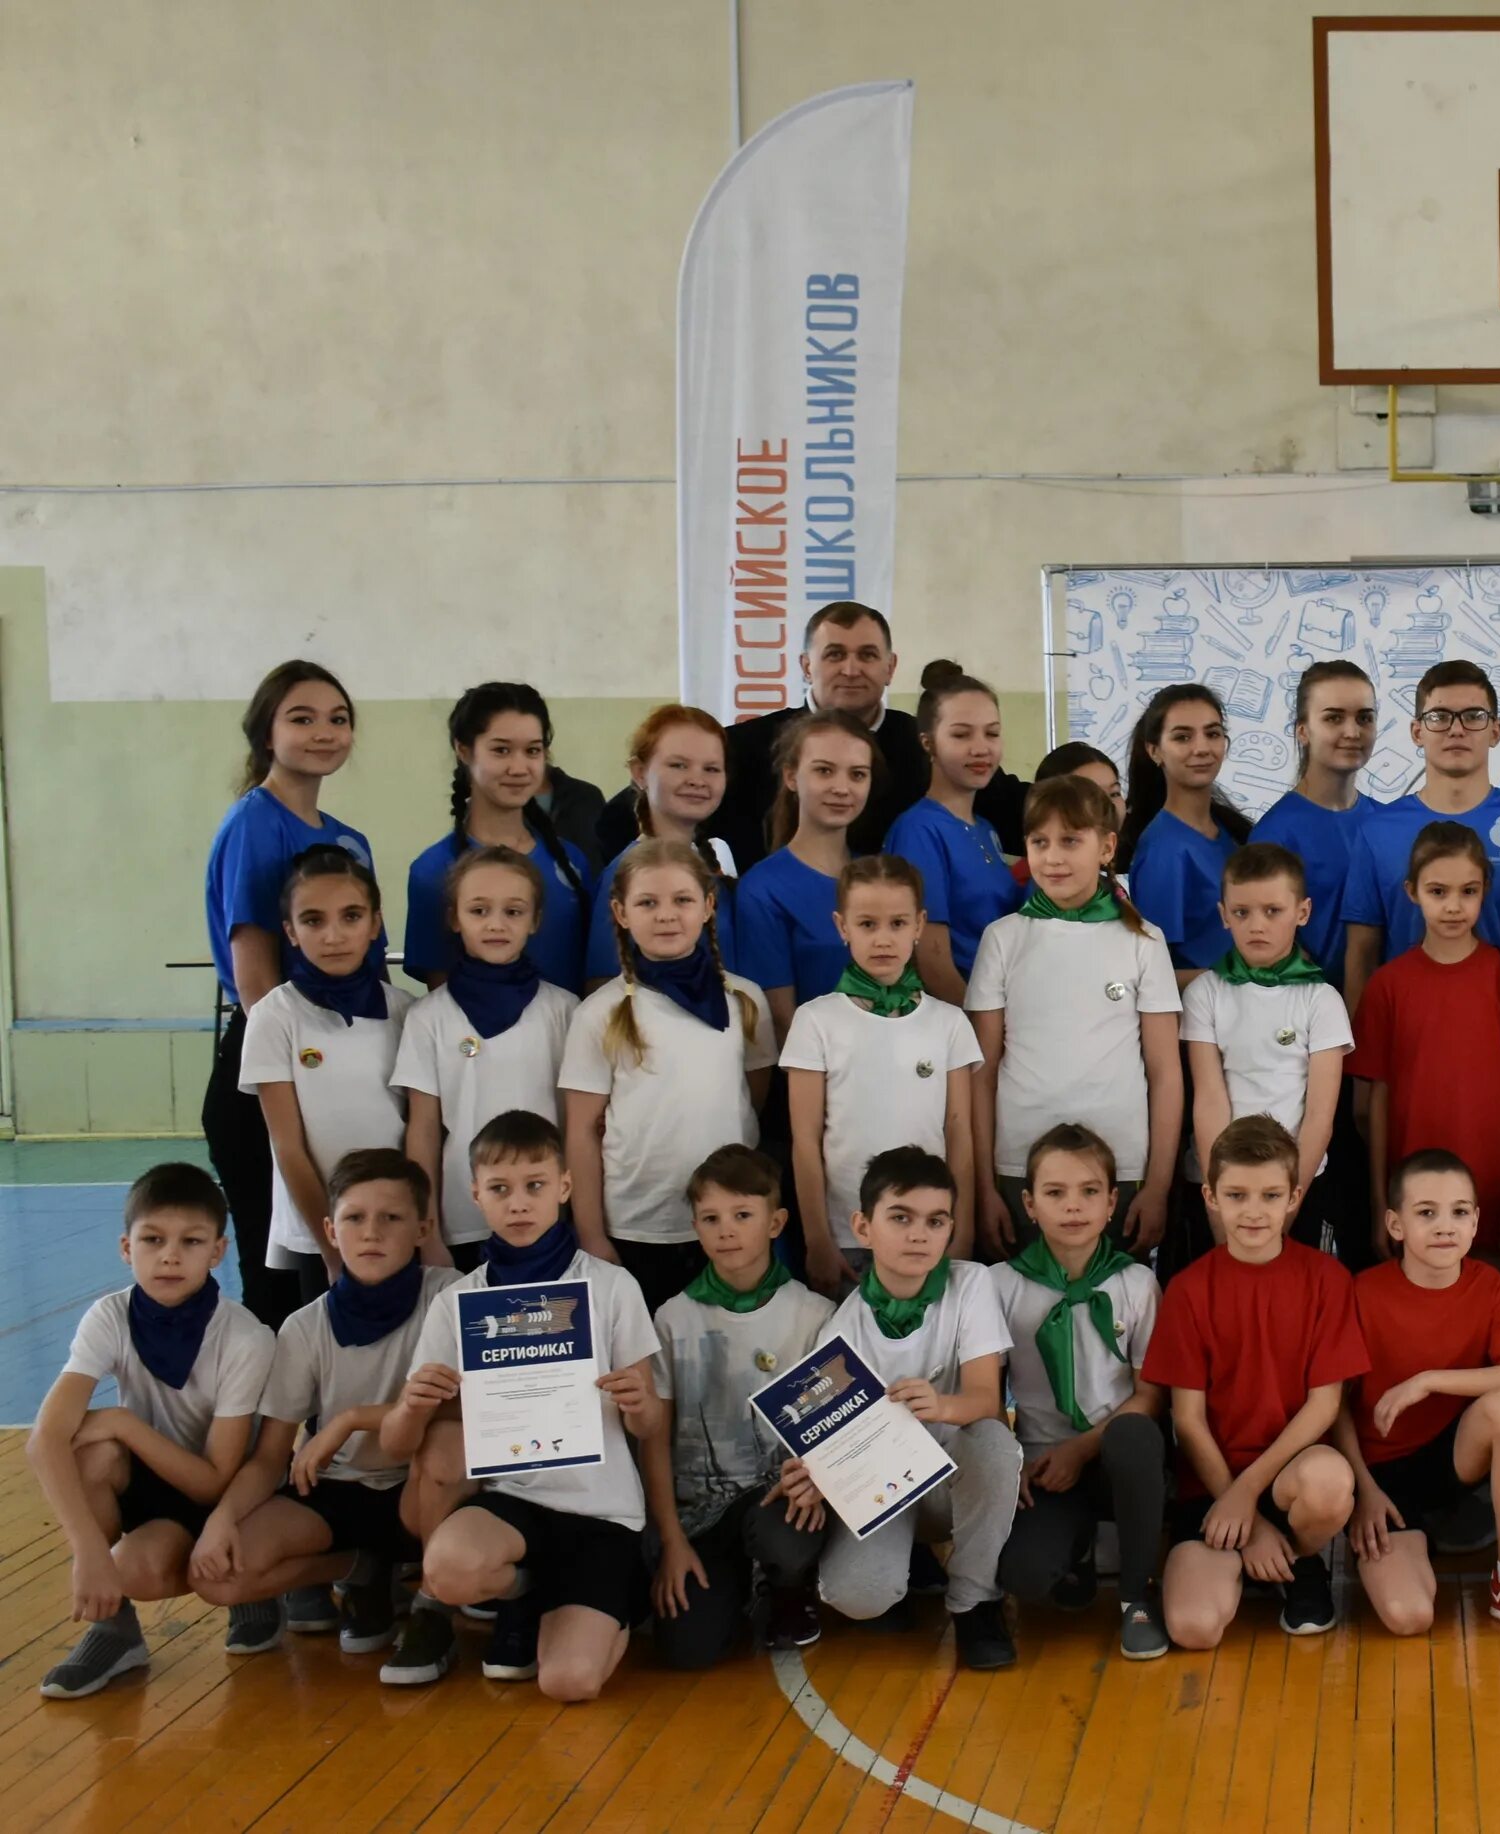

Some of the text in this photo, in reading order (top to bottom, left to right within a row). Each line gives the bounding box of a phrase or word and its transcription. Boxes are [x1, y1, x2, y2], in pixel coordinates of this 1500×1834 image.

[804, 273, 860, 600] ШКОЛЬНИКОВ
[730, 437, 789, 724] ОССИЙСКОЕ
[481, 1341, 575, 1363] СЕРТИФИКАТ
[800, 1389, 870, 1445] СЕРТИФИКАТ
